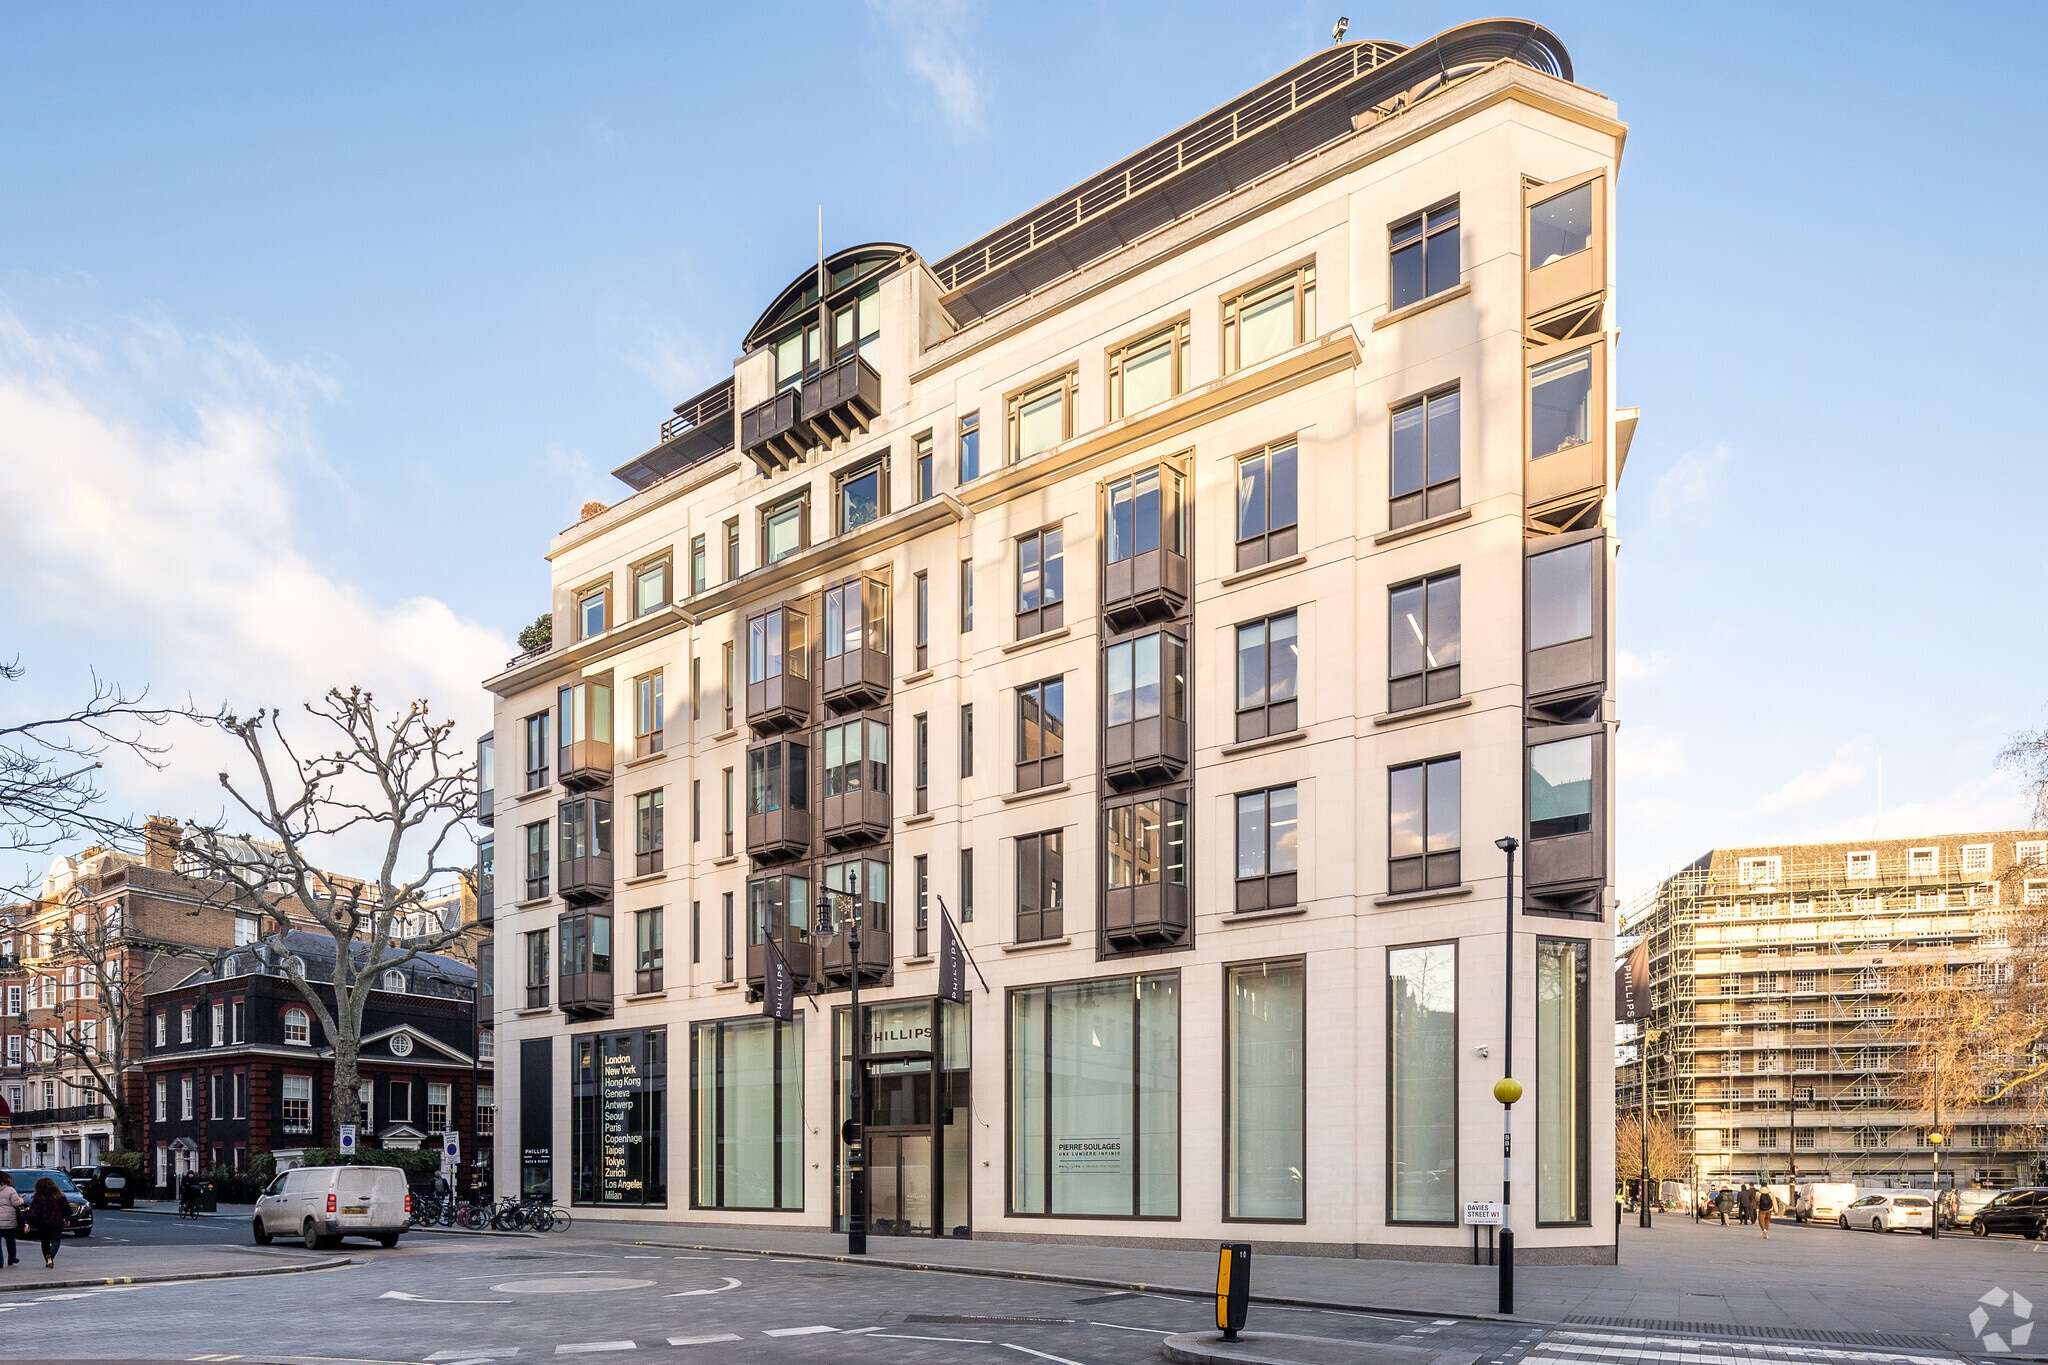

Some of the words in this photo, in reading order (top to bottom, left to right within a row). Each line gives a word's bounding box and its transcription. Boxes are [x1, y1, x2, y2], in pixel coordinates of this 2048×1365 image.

[1624, 964, 1635, 1018] PHILLIPS
[865, 1027, 931, 1042] PHILLIPS
[604, 1054, 631, 1065] London
[604, 1066, 620, 1076] New
[620, 1064, 637, 1075] York
[604, 1077, 623, 1088] Hong
[623, 1076, 641, 1087] Kong
[604, 1089, 630, 1098] Geneva
[604, 1100, 633, 1110] Antwerp
[604, 1111, 624, 1121] Seoul
[604, 1122, 622, 1132] Paris
[604, 1134, 643, 1144] Copenhage
[604, 1145, 625, 1156] Taipei
[1059, 1143, 1083, 1151] PIERRE
[1083, 1142, 1121, 1150] SOULAGES
[604, 1156, 625, 1167] Tokyo
[604, 1167, 626, 1177] Zurich
[604, 1179, 617, 1189] Los
[617, 1179, 643, 1190] Angeles
[604, 1190, 622, 1200] Milan
